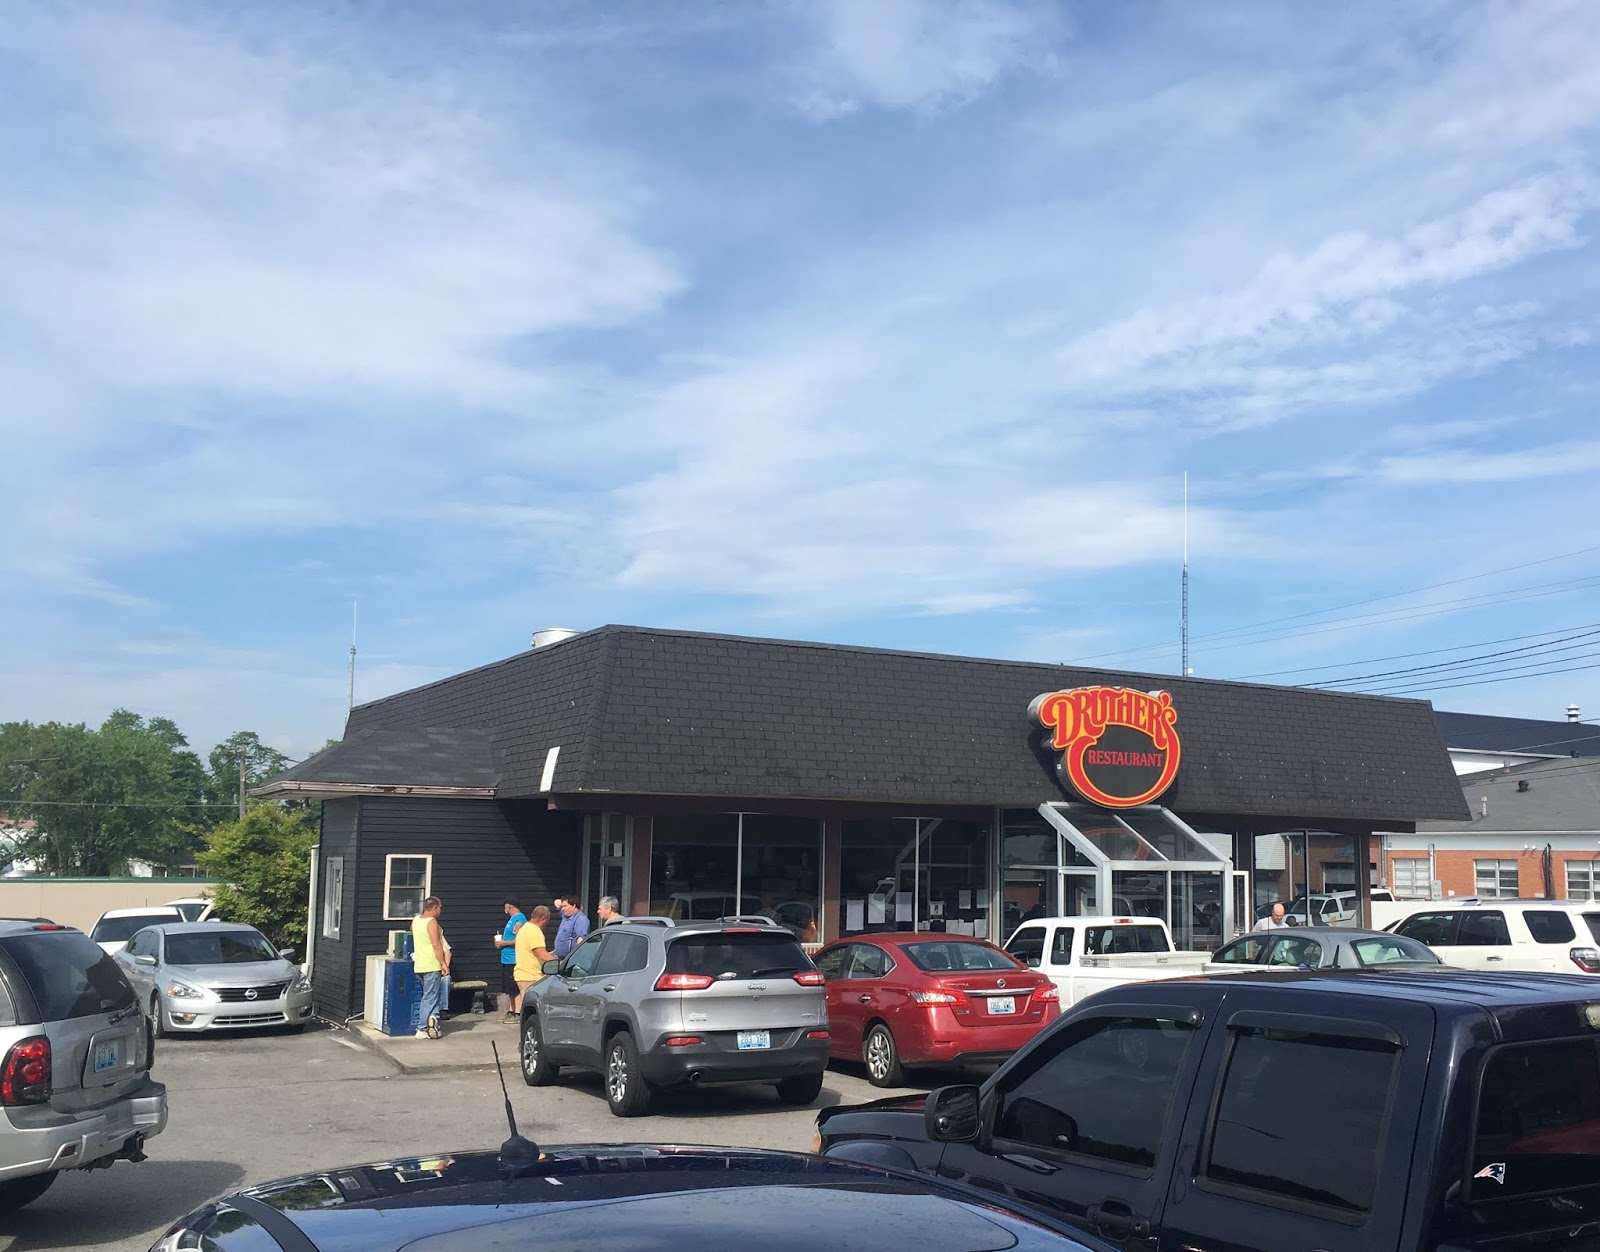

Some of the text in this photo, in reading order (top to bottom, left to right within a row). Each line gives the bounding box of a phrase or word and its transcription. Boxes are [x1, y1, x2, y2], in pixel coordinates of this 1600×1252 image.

[1041, 687, 1178, 749] DRUTHER'S
[1088, 750, 1164, 767] RESTAURANT
[747, 983, 767, 991] Jeep
